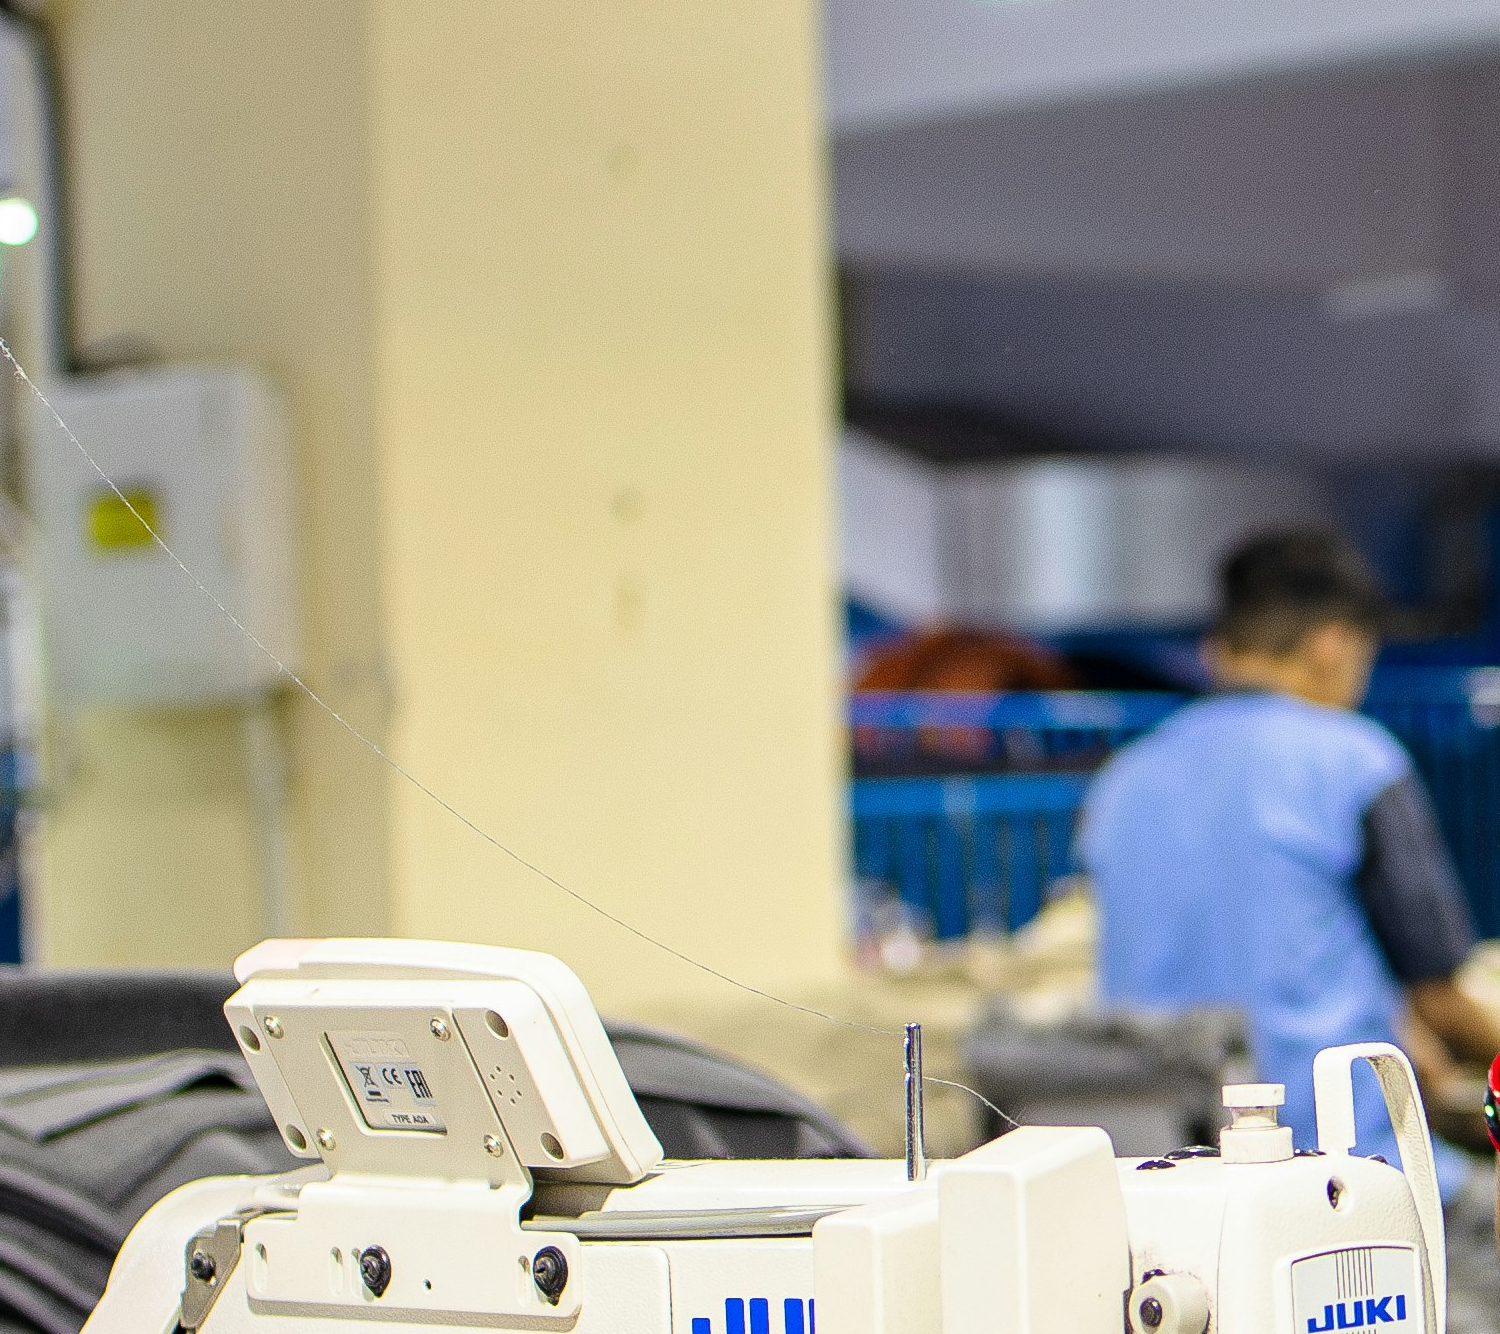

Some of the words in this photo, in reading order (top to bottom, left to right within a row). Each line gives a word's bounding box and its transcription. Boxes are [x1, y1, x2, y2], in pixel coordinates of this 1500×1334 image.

[382, 1068, 402, 1085] CE
[391, 1114, 412, 1124] TYPE
[1307, 1294, 1406, 1334] JUKI
